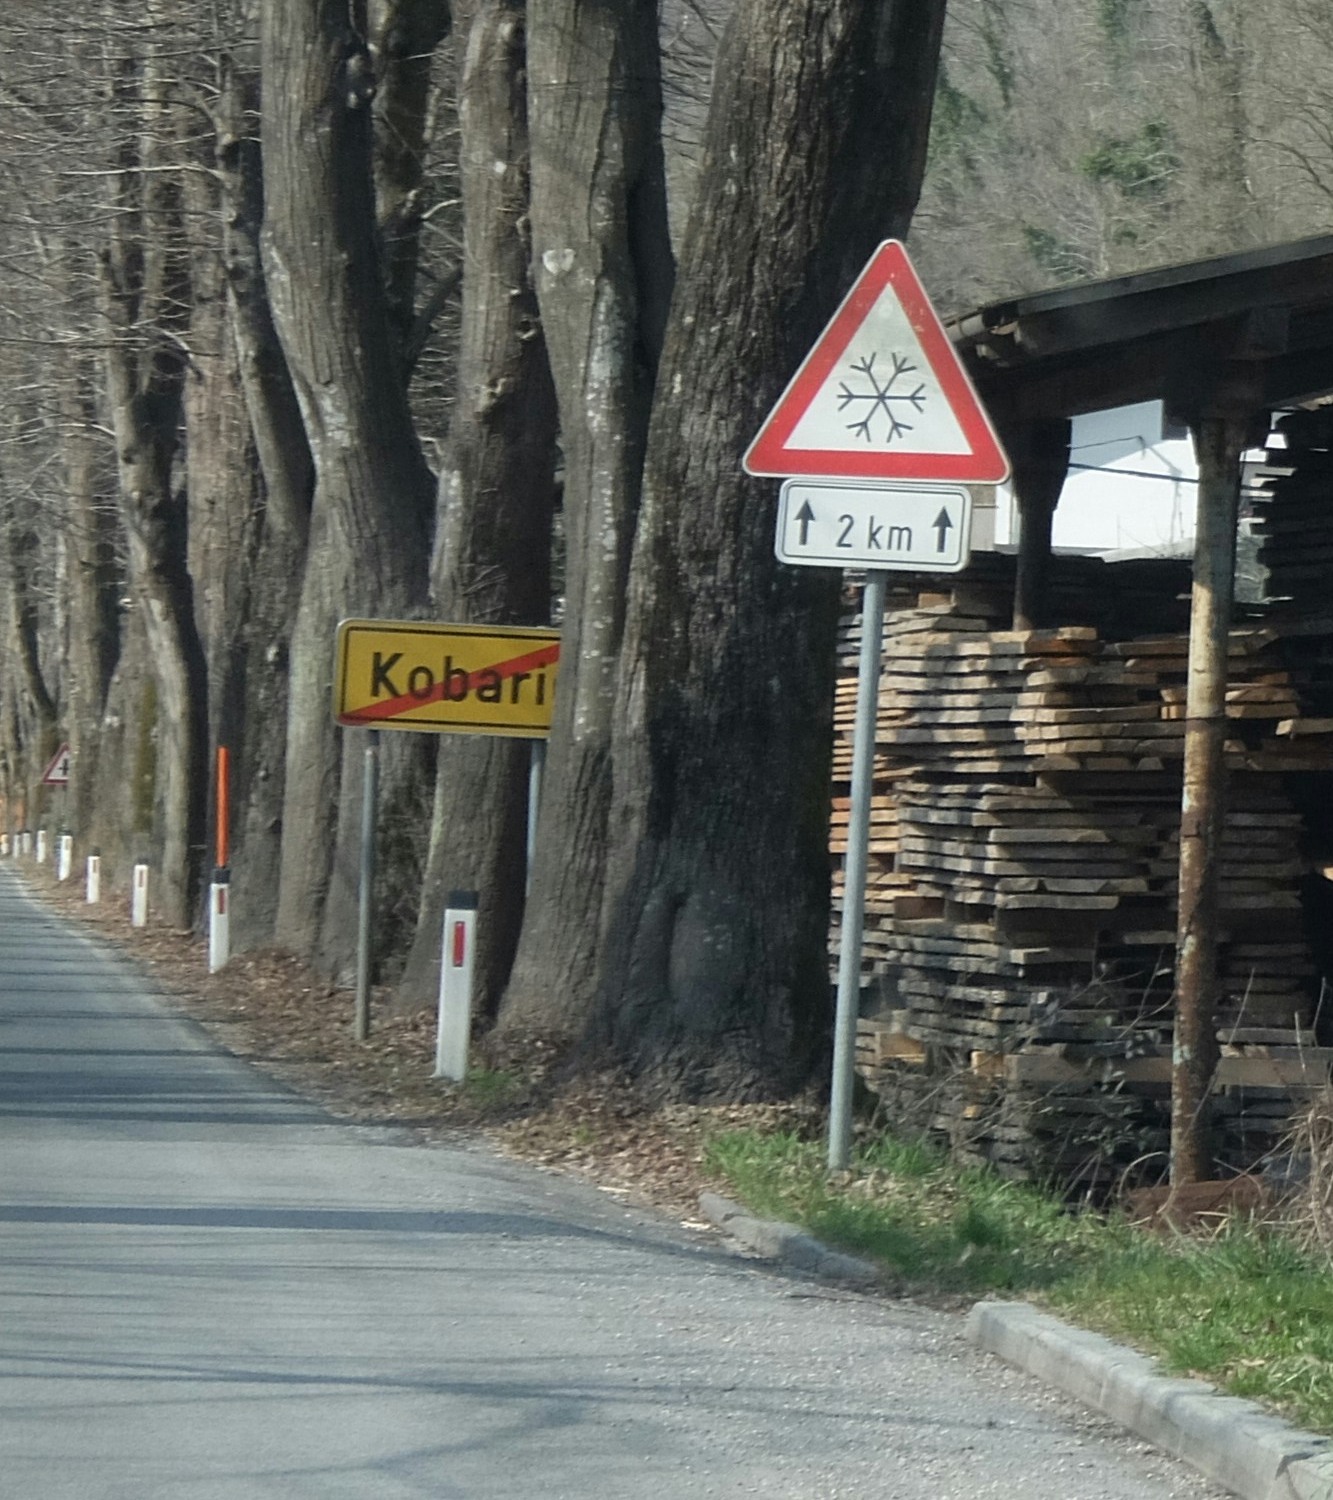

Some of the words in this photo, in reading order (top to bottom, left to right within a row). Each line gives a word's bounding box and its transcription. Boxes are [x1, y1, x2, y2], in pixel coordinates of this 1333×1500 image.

[835, 514, 855, 549] 2
[867, 515, 913, 551] km
[370, 651, 557, 705] Kobari
